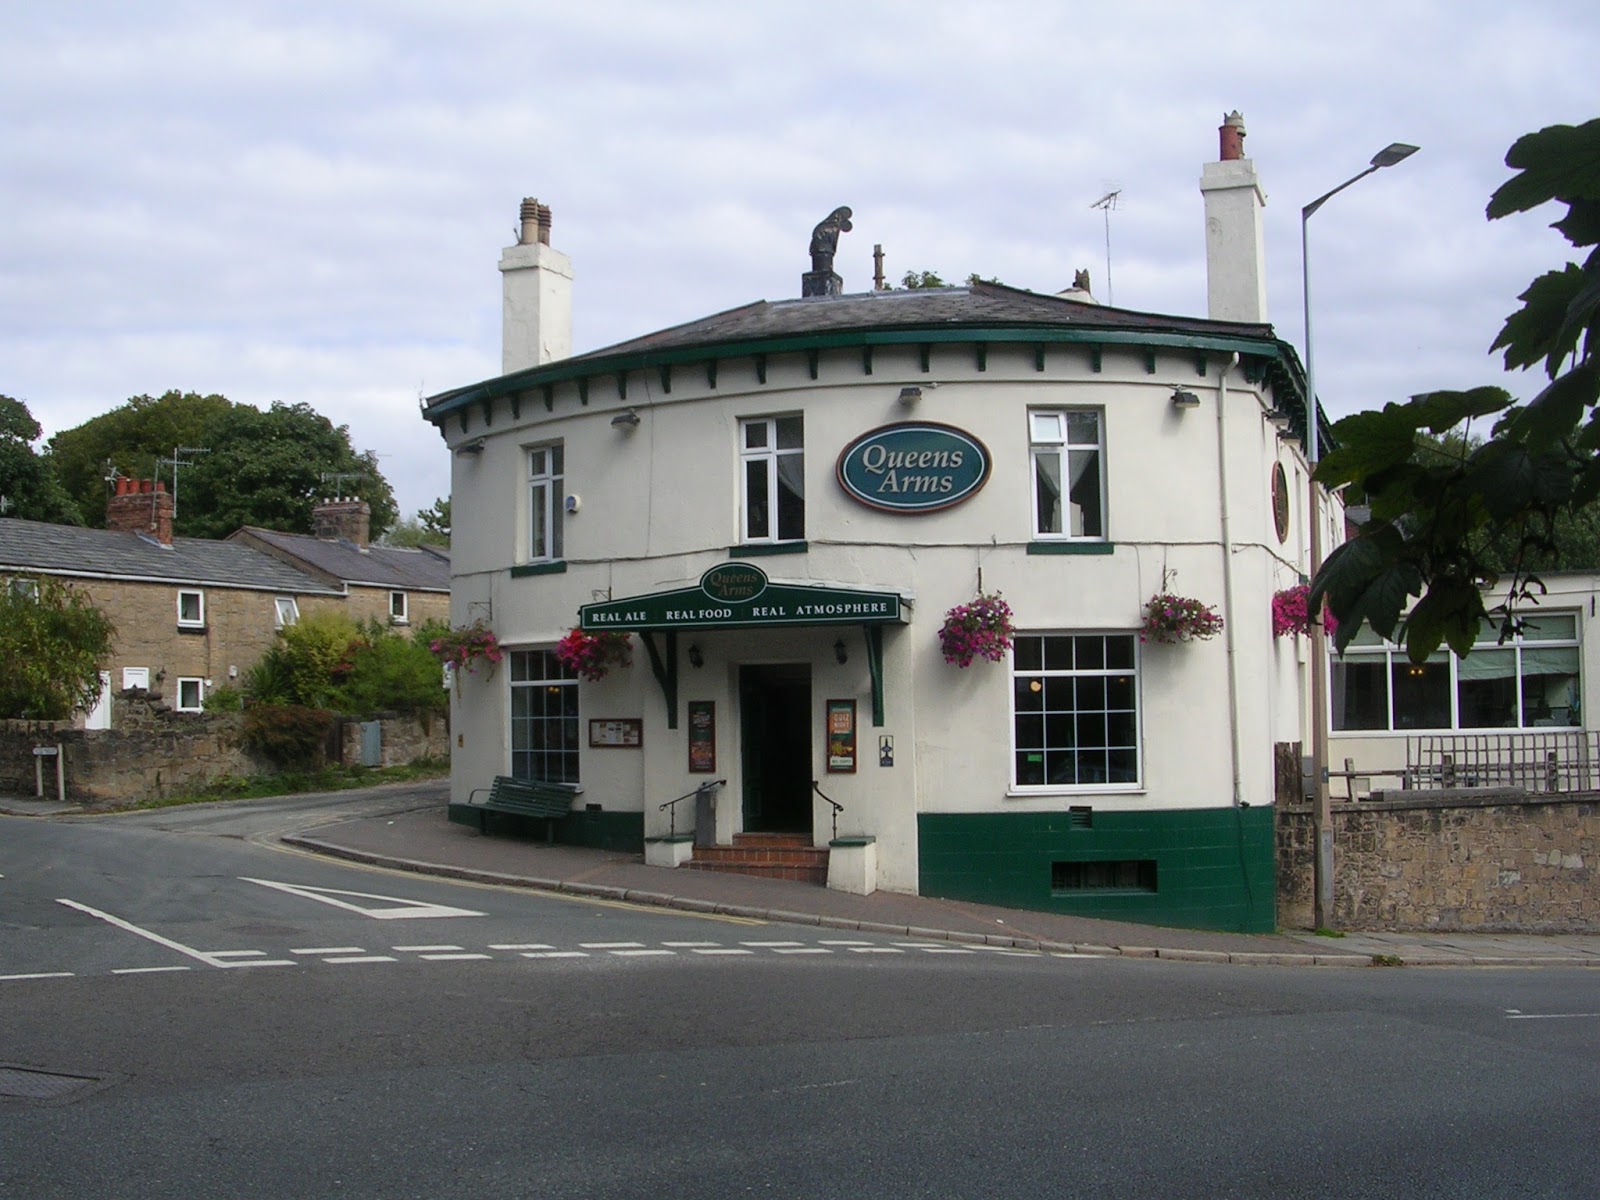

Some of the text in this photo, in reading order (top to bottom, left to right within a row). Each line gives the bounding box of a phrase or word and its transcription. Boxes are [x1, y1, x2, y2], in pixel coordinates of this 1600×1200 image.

[862, 444, 964, 475] Queens
[877, 469, 953, 493] Arms
[710, 571, 758, 587] Queens
[718, 584, 753, 597] Arms
[592, 602, 887, 622] REAL ALE REAL FOOD REAL ATMOSPHERE
